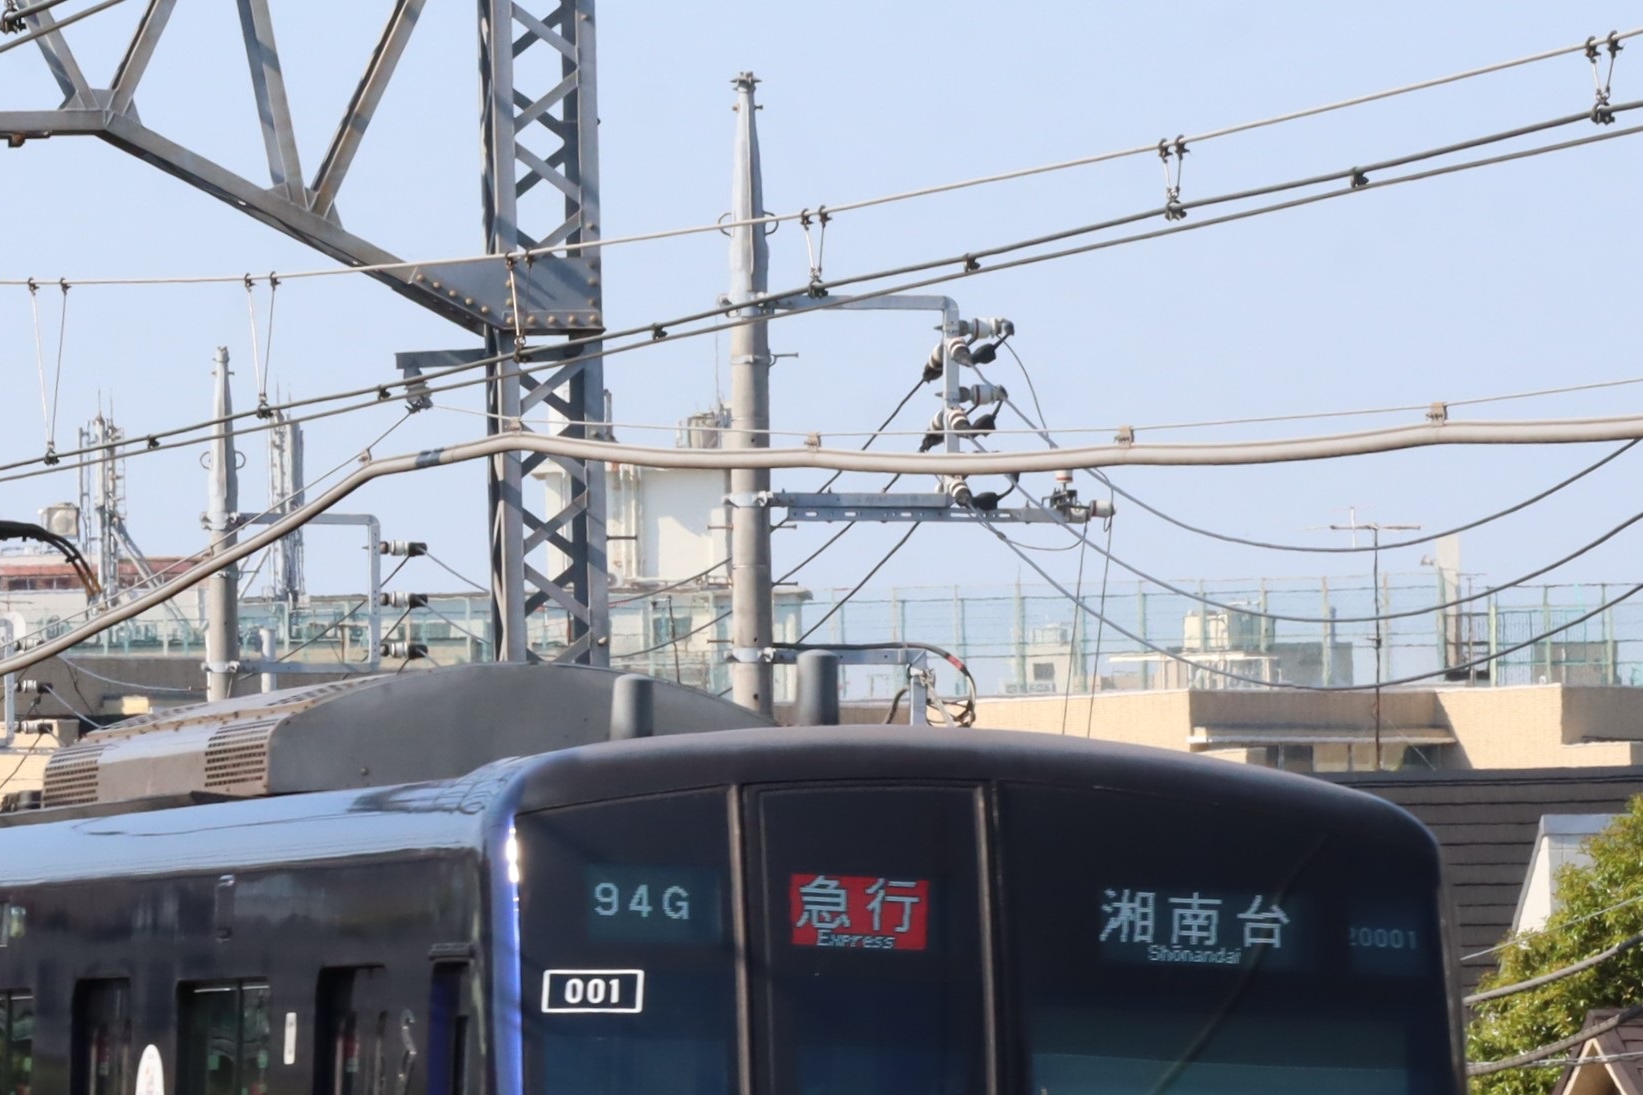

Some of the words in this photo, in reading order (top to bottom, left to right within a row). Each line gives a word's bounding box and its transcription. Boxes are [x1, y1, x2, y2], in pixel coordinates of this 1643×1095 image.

[594, 882, 691, 921] 94G
[796, 875, 921, 934] 急行
[1099, 888, 1290, 949] 湘南台
[816, 929, 896, 949] Express
[564, 977, 620, 1004] 001
